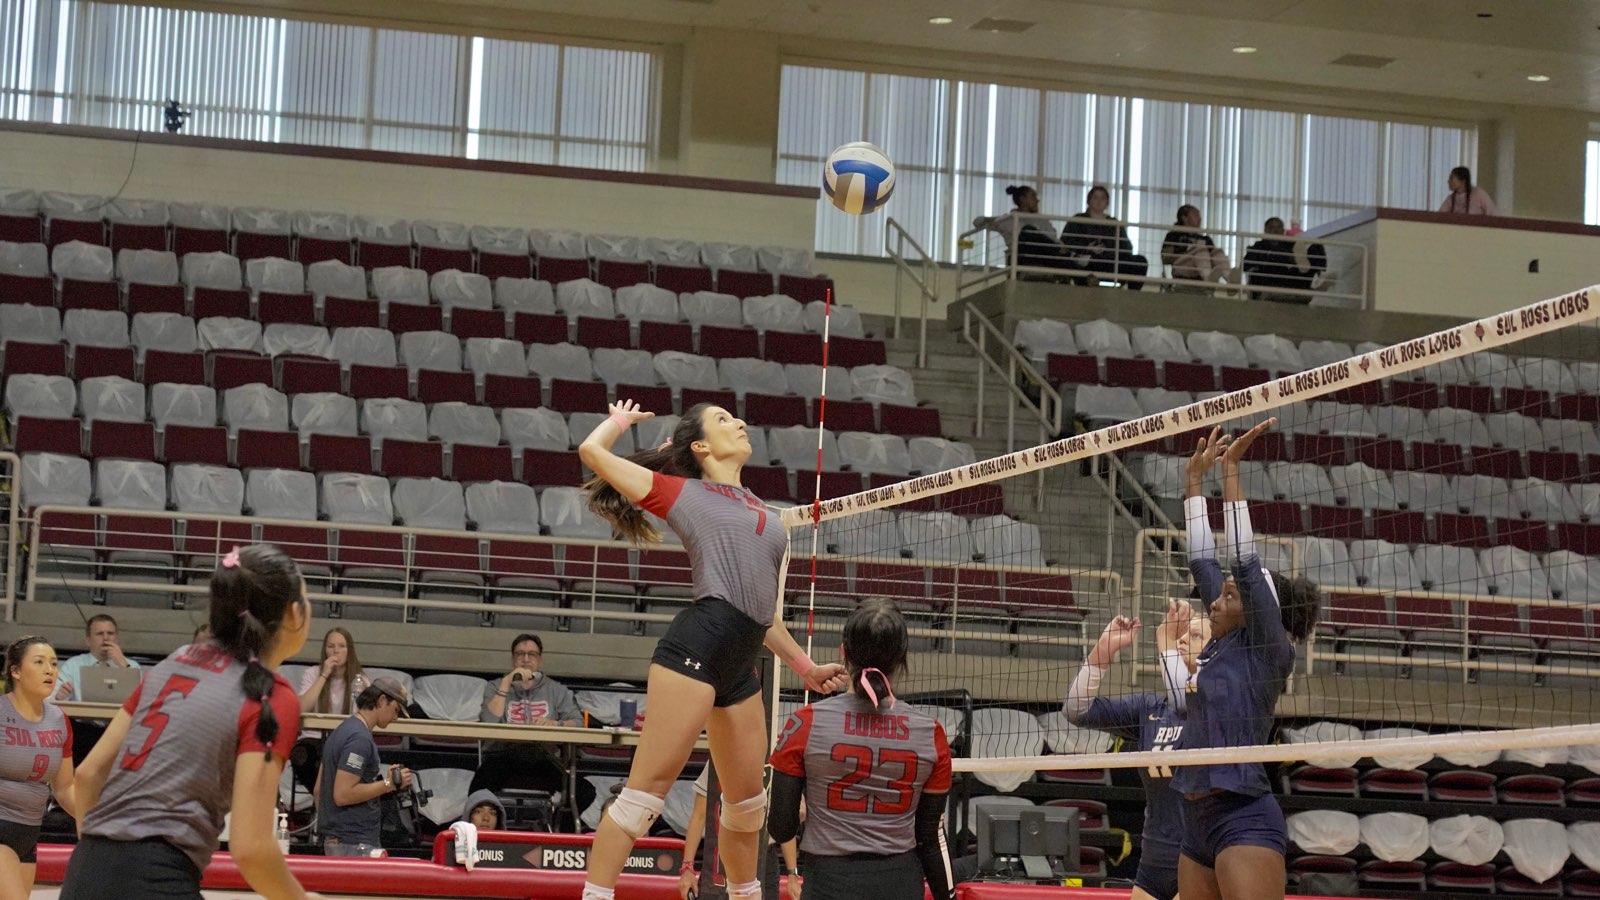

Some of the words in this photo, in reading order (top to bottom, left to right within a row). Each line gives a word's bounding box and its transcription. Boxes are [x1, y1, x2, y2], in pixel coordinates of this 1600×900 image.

[1496, 313, 1517, 336] SUL
[1520, 304, 1550, 330] ROSS
[1553, 291, 1589, 320] LOBOS
[1380, 348, 1398, 369] SUL
[1400, 339, 1426, 363] ROSS
[1429, 329, 1461, 355] LOBOS
[1279, 379, 1294, 398] SUL
[1296, 370, 1320, 392] ROSS
[1321, 361, 1349, 385] LOBOS
[1187, 406, 1202, 422] SUL
[1204, 398, 1225, 418] ROSS
[1225, 390, 1253, 412] LOBOS
[1107, 428, 1120, 444] SUL
[1121, 421, 1139, 440] ROSS
[1140, 414, 1165, 435] LOBOS
[1034, 448, 1047, 463] SUL
[1047, 442, 1064, 460] ROSS
[5, 726, 36, 748] SUL
[119, 673, 200, 773] 5
[844, 711, 910, 741] LOBOS
[1154, 726, 1184, 743] HPU
[26, 754, 50, 782] 9
[827, 743, 919, 815] 23
[479, 849, 504, 862] ONUS
[542, 849, 586, 869] POSS
